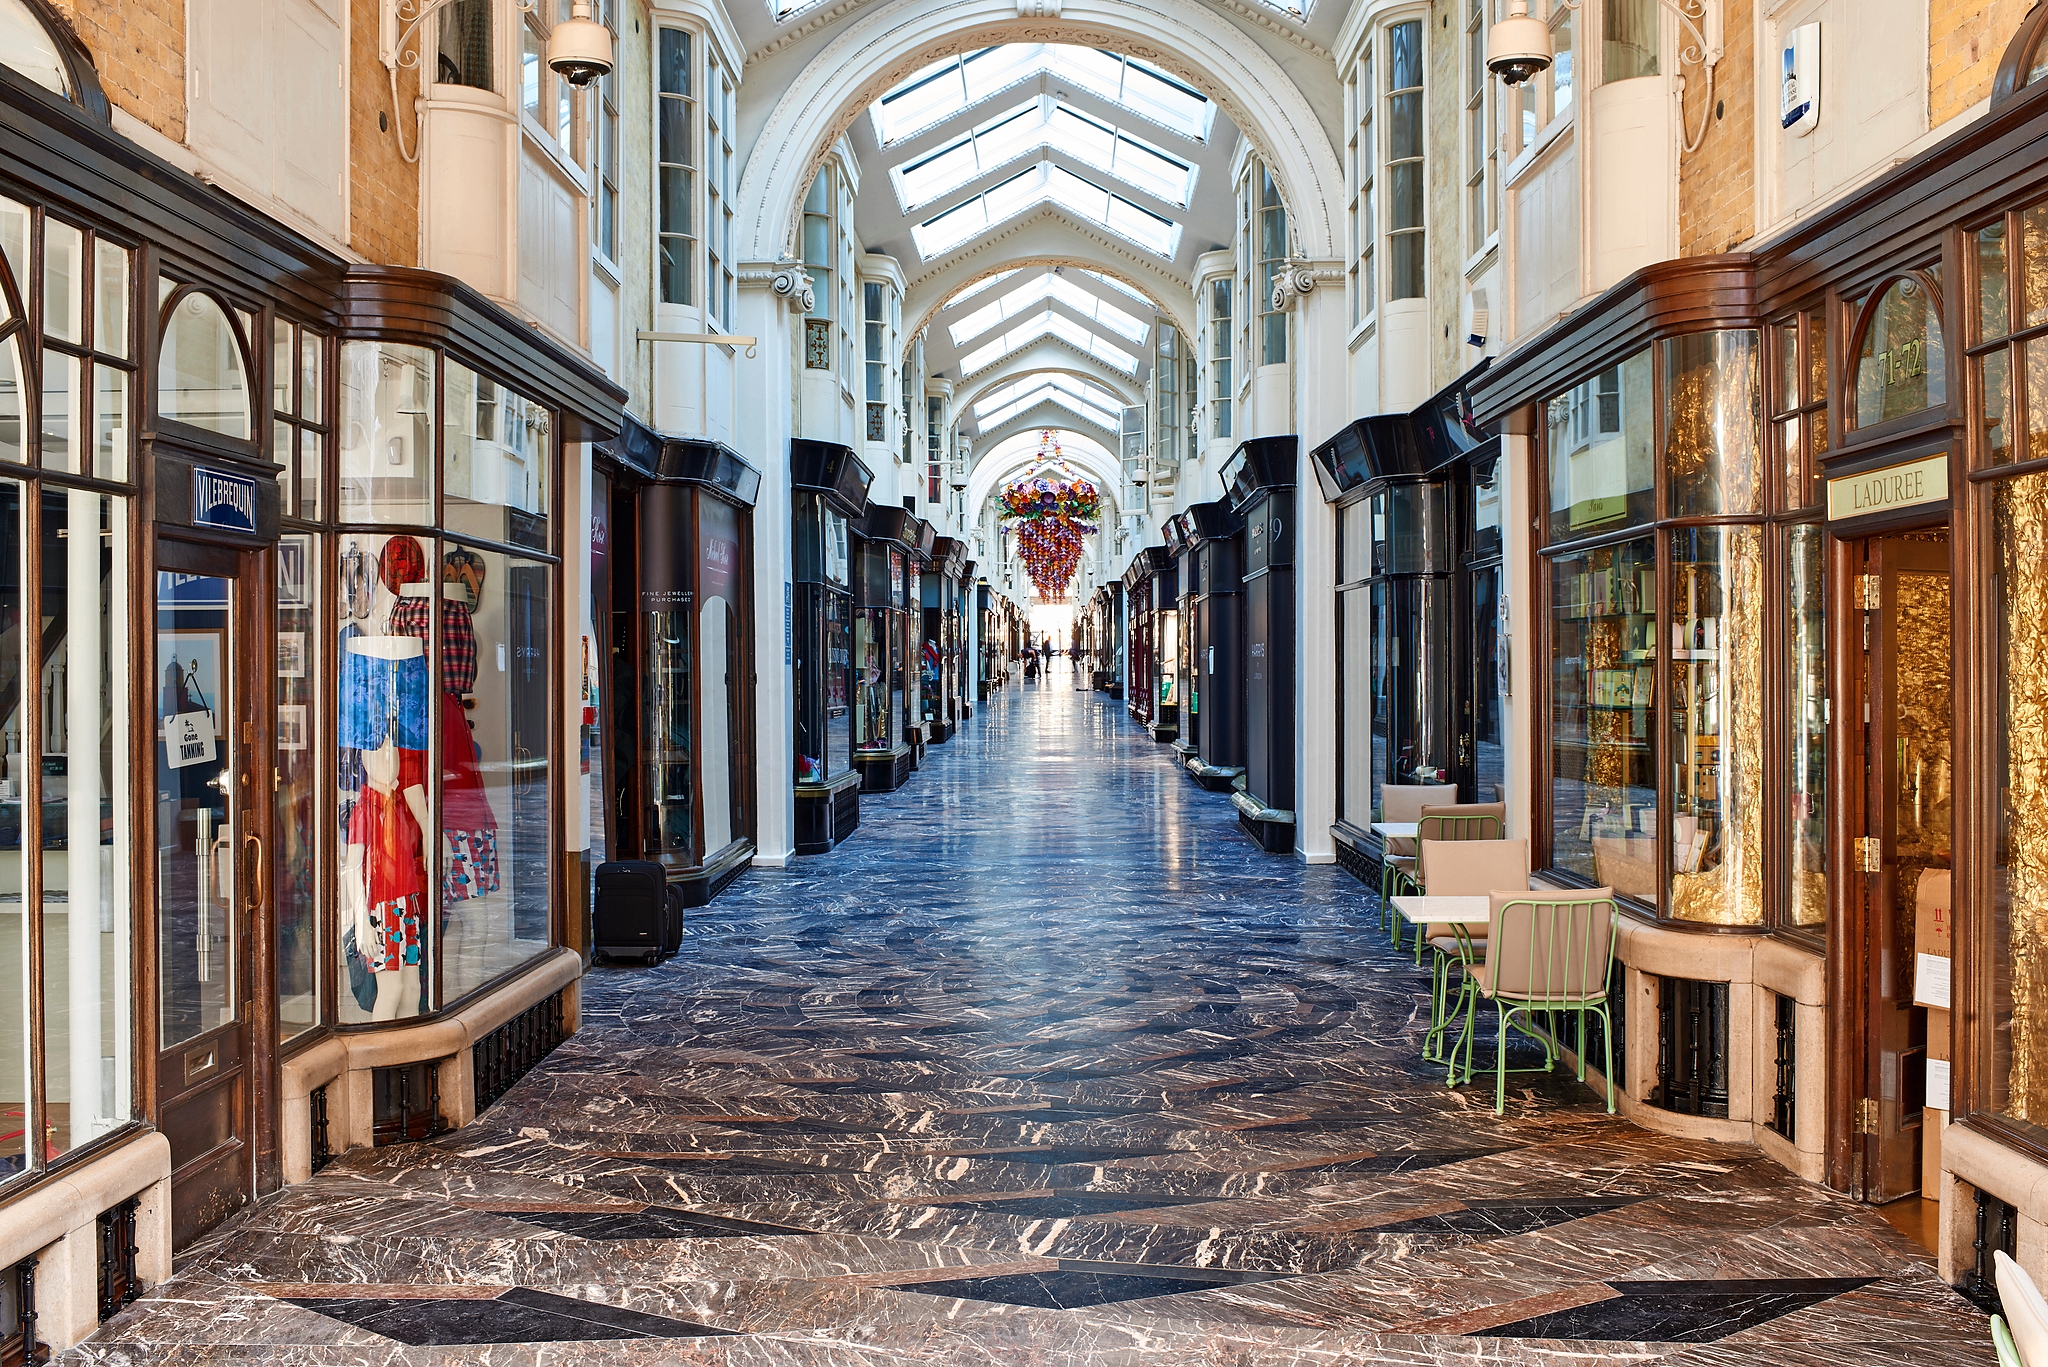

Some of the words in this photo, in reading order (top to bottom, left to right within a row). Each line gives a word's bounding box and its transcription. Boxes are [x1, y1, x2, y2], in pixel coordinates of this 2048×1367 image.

[1878, 338, 1922, 388] 71-72
[826, 460, 835, 473] 4
[1854, 470, 1924, 509] LADUREE
[198, 475, 253, 526] VILEBREQUIN
[184, 733, 198, 742] Gone
[180, 742, 204, 760] TANNING
[1927, 948, 1949, 957] LADU
